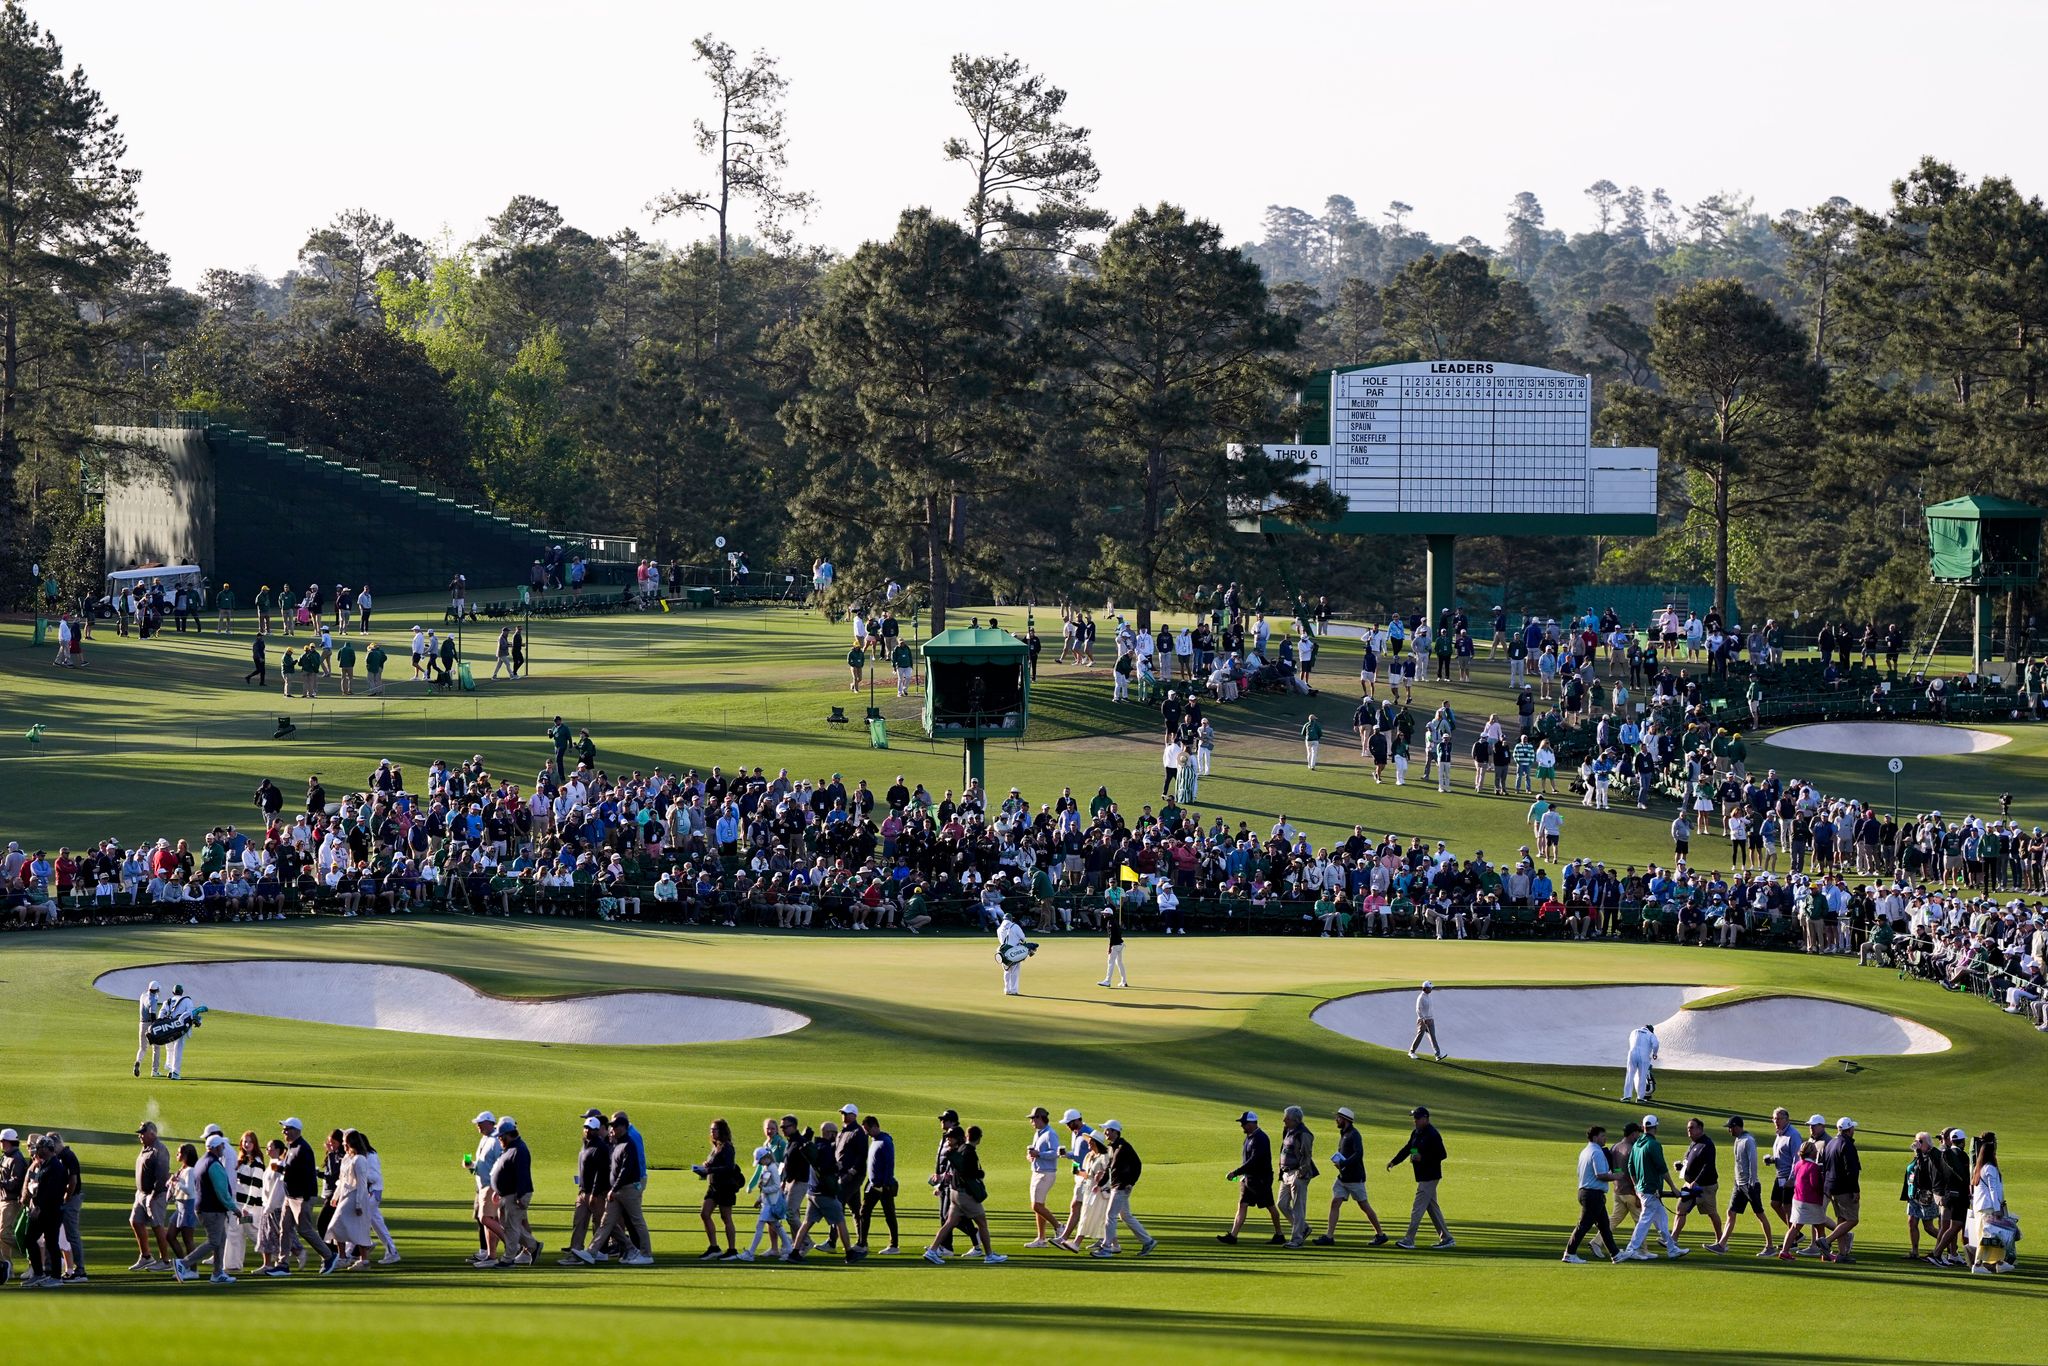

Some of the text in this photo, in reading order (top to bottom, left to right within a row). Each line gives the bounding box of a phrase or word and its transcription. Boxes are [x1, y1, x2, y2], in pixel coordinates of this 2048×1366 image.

[1431, 364, 1494, 373] LEADERS
[1362, 377, 1388, 385] HOLE
[1415, 378, 1420, 386] 2
[1425, 378, 1431, 386] 3
[1435, 378, 1440, 386] 4
[1445, 378, 1451, 386] 5
[1455, 378, 1461, 386] 6
[1465, 378, 1471, 386] 7
[1475, 378, 1481, 387] 8
[1486, 378, 1491, 387] 9
[1496, 379, 1504, 387] 10
[1508, 379, 1514, 387] 11
[1517, 379, 1525, 387] 12
[1527, 379, 1535, 387] 13
[1537, 379, 1545, 387] 14
[1547, 379, 1555, 387] 15
[1557, 379, 1565, 387] 16
[1567, 379, 1575, 387] 17
[1578, 379, 1585, 387] 18
[1351, 400, 1379, 408] McILROY
[1351, 412, 1376, 420] HOWELL
[1350, 423, 1371, 431] SPAUN
[1351, 434, 1387, 442] SCHEFFLER
[1350, 446, 1368, 454] FANG
[1275, 450, 1318, 459] THRU 6
[1350, 457, 1369, 465] HOLTZ
[1893, 761, 1899, 770] 3
